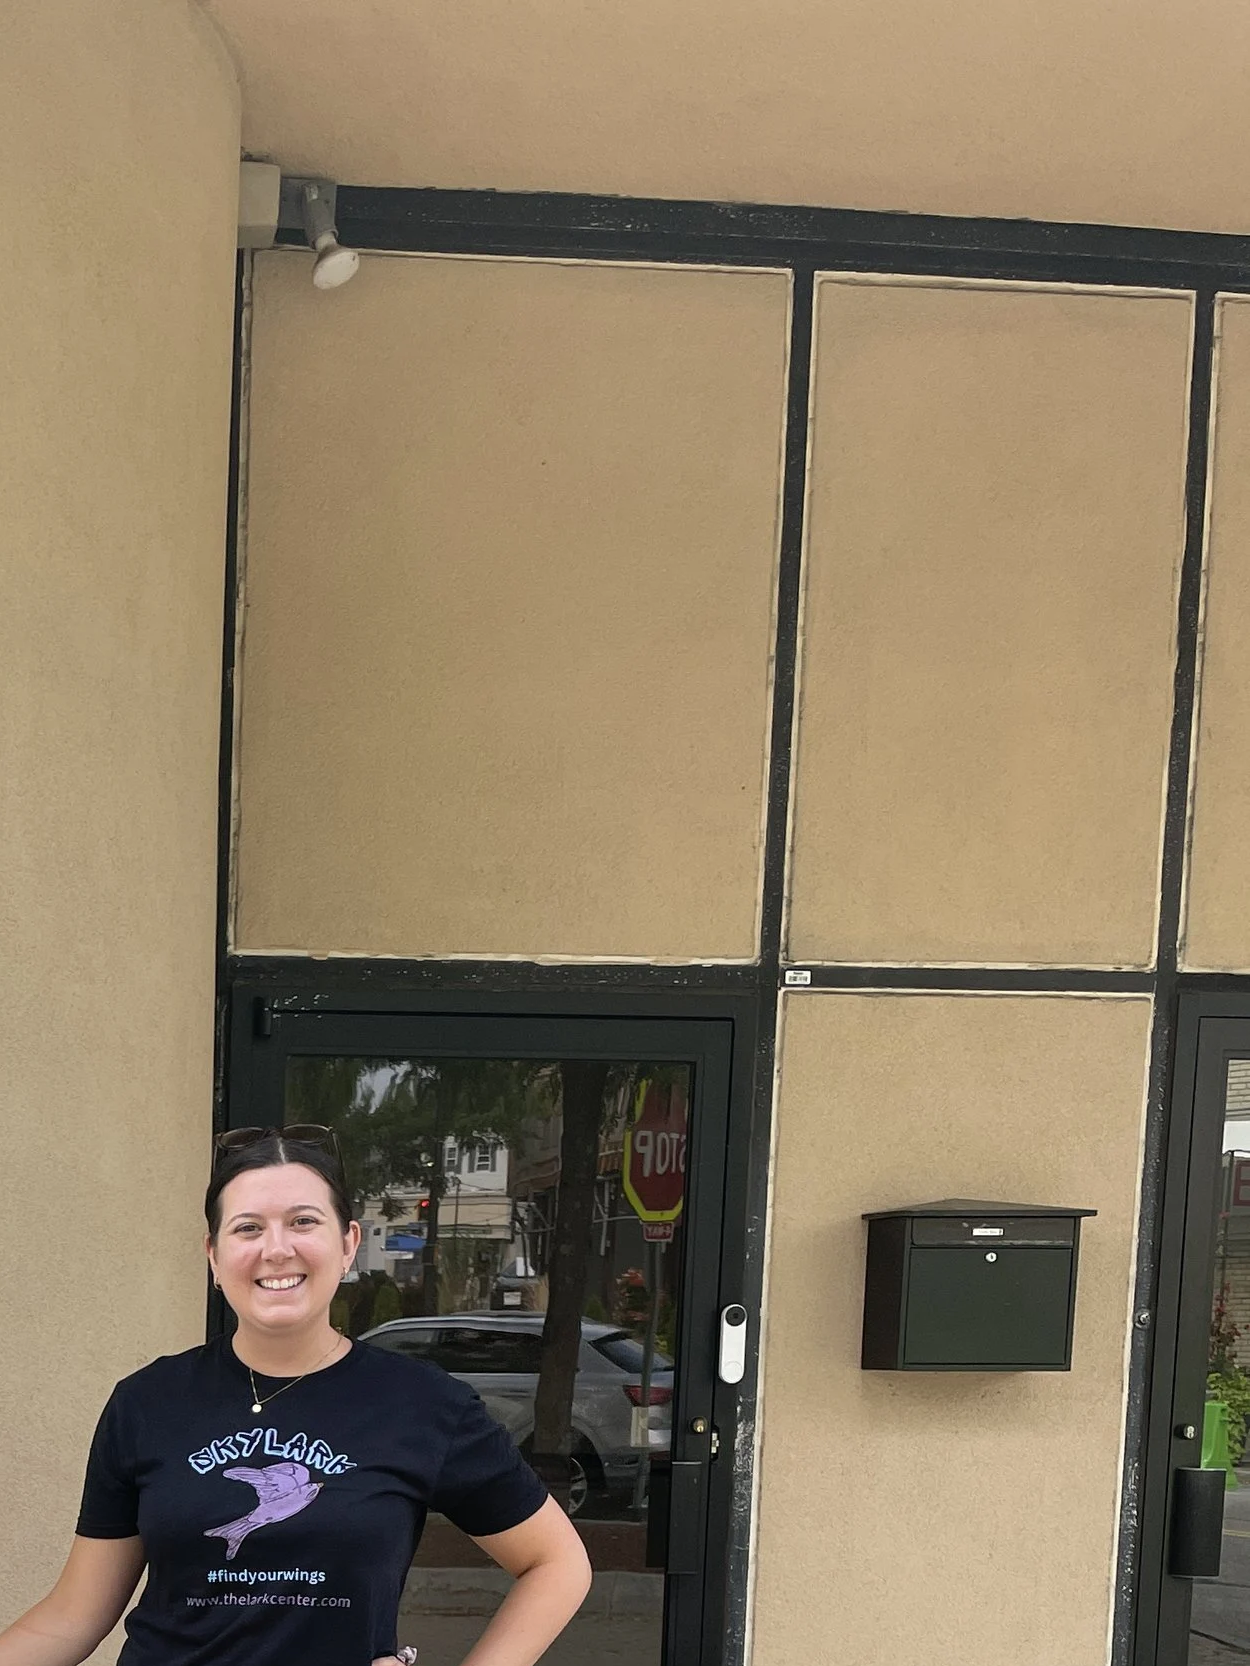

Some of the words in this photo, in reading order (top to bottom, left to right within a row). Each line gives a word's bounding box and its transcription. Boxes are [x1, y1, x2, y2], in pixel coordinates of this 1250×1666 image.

[188, 1428, 357, 1474] SKYLARK
[207, 1567, 326, 1585] #findyourwings
[186, 1593, 351, 1608] www.thelarkcenter.com
